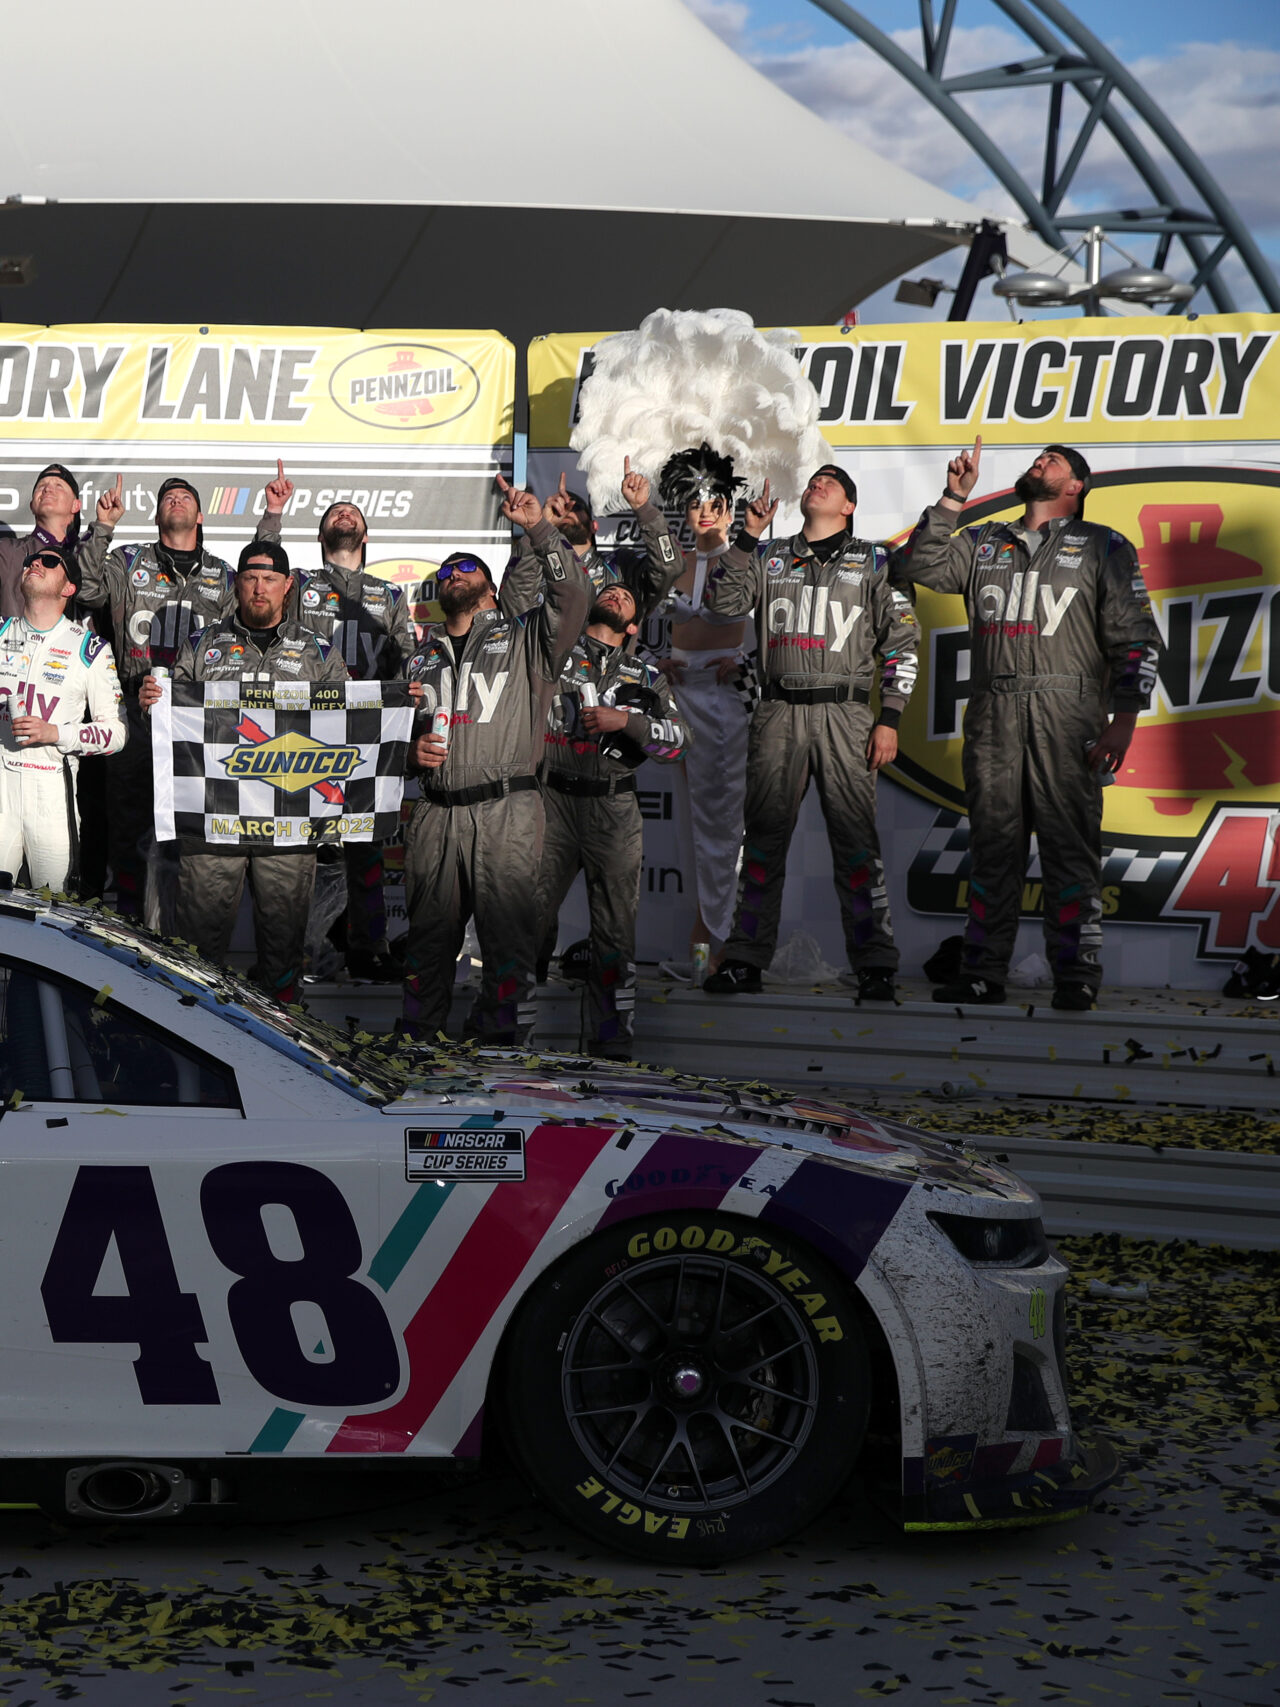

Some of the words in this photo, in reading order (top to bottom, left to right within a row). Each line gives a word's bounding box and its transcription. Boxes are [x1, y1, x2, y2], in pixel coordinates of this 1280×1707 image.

[138, 341, 319, 424] LANE
[349, 367, 464, 404] PENNZOIL
[940, 331, 1275, 425] VICTORY
[769, 585, 864, 652] ally
[978, 570, 1080, 637] ally
[30, 633, 46, 643] ally
[205, 699, 282, 710] PRESENTED
[286, 701, 304, 711] BY
[310, 700, 346, 711] JIFFY
[349, 699, 385, 709] LUBE
[246, 689, 311, 700] PENNZOIL
[315, 689, 339, 700] 400
[79, 726, 113, 748] ally
[650, 719, 684, 749] ally
[231, 750, 355, 774] SUNOCO
[211, 818, 292, 837] MARCH
[299, 820, 318, 838] 6,
[324, 817, 376, 835] 2022
[444, 1133, 506, 1149] NASCAR
[422, 1154, 454, 1170] CUP
[456, 1154, 508, 1170] SERIES
[39, 1160, 402, 1407] 48
[626, 1225, 845, 1344] GOODYEAR
[575, 1474, 692, 1540] EAGLE
